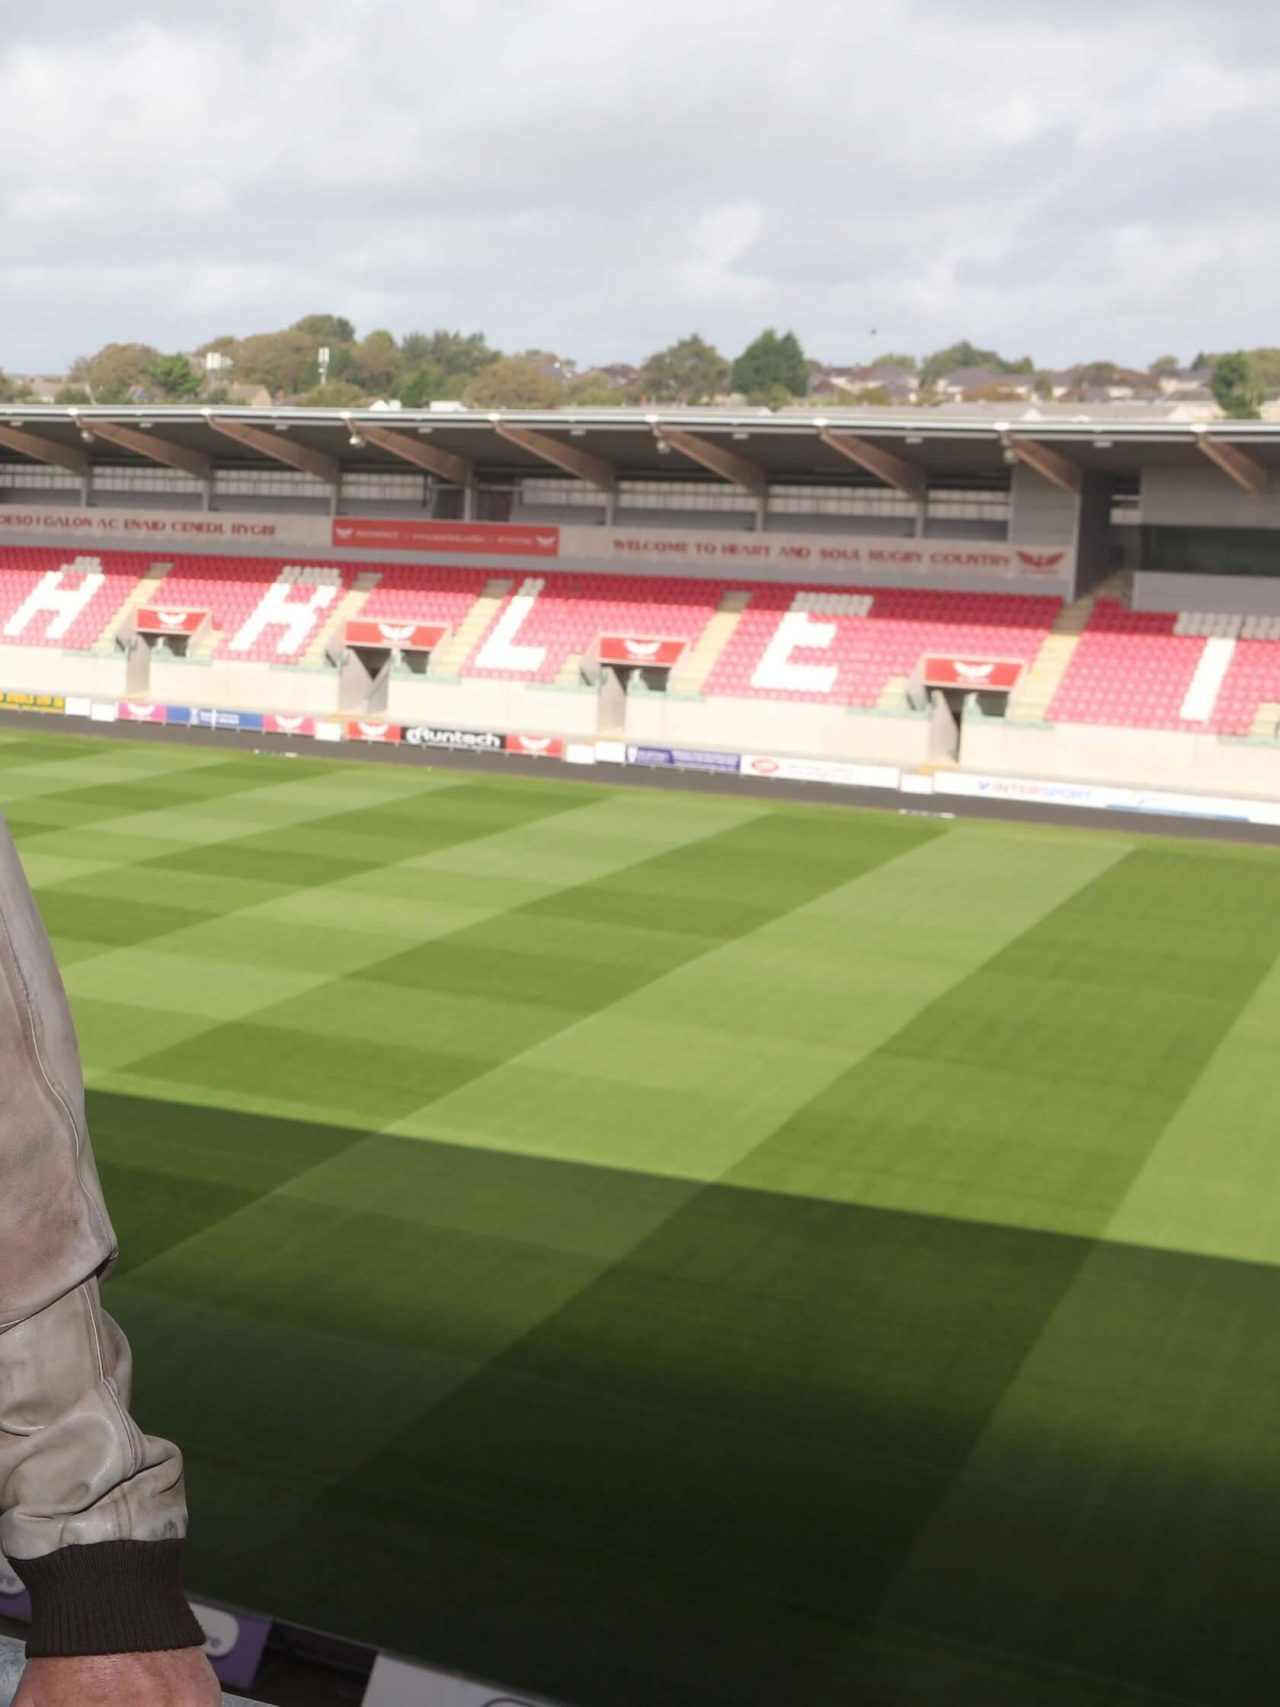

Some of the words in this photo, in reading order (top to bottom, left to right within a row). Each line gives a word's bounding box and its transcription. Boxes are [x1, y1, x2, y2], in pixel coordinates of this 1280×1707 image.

[612, 539, 688, 552] WELCOME
[694, 541, 718, 554] TO
[721, 543, 770, 556] HEART
[778, 546, 812, 558] AND
[819, 547, 861, 561] SOUL
[867, 549, 924, 563] RUGBY
[930, 552, 1010, 567] COUNTRY
